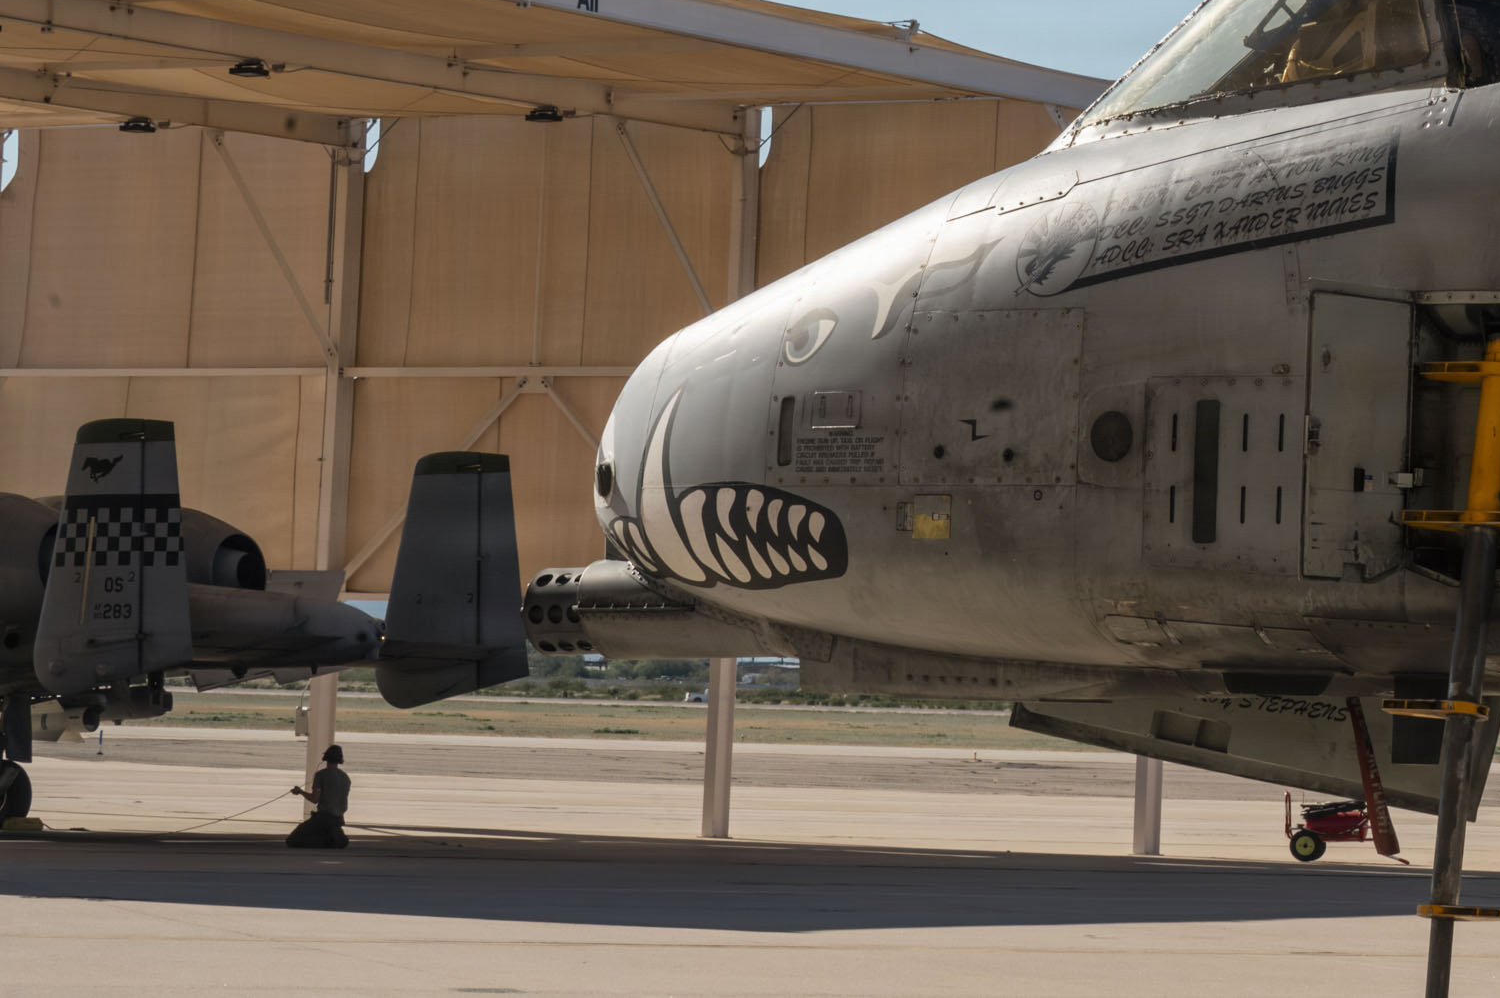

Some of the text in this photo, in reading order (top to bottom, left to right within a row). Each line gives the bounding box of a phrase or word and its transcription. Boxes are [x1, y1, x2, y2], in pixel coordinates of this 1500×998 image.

[1155, 201, 1214, 227] SSGT
[1219, 183, 1307, 213] DARIUS
[1312, 167, 1385, 194] BUGGS
[1162, 224, 1209, 251] SRA
[1213, 206, 1302, 240] XANDER
[1305, 191, 1379, 220] NUNES
[127, 570, 137, 582] 2
[104, 577, 125, 593] OS
[103, 603, 132, 619] 283
